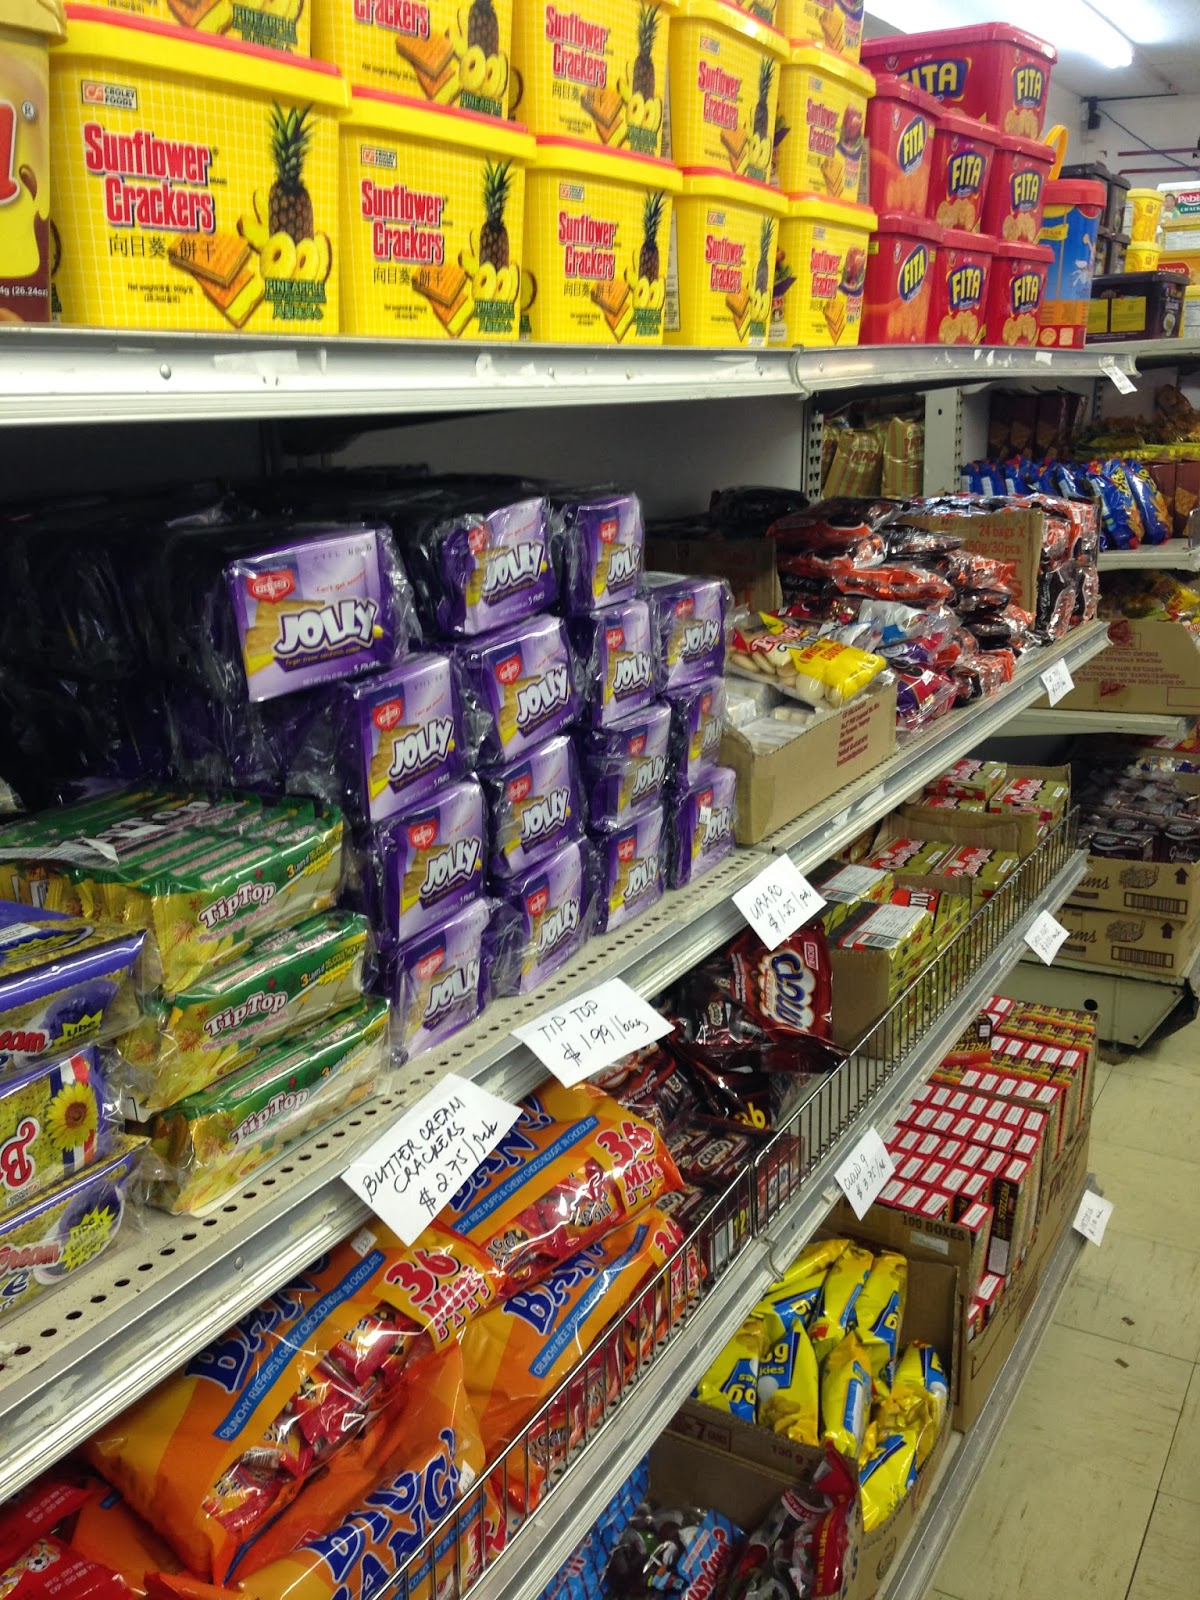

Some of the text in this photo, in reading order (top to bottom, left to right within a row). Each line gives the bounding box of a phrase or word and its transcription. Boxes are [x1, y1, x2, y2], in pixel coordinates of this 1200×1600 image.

[353, 0, 431, 40] Crackers
[545, 4, 608, 55] Sunflower
[552, 41, 607, 88] Crackers
[698, 59, 742, 103] Sunflower
[1017, 68, 1043, 101] FITA
[703, 91, 739, 131] Crackers
[84, 122, 212, 186] Sunflower
[903, 121, 925, 165] FITA
[952, 154, 982, 195] FITA
[1014, 173, 1039, 206] FITA
[104, 174, 216, 235] Crackers
[361, 177, 444, 228] Sunflower
[372, 219, 445, 267] Crackers
[558, 211, 617, 251] Sunflower
[705, 234, 745, 269] Sunflower
[564, 244, 616, 281] Crackers
[710, 262, 742, 295] Crackers
[811, 246, 842, 277] Sunflower
[903, 248, 925, 294] FITA
[265, 278, 326, 298] PINEAPPLE
[811, 271, 840, 300] Crackers
[952, 268, 981, 304] FITA
[1014, 275, 1039, 308] FITA
[993, 527, 1015, 540] bags
[482, 540, 545, 598] JOLLY
[273, 598, 378, 657] JOLLY
[681, 618, 720, 657] JOLLY
[515, 662, 570, 729] JOLLY
[612, 651, 652, 695] JOLLY
[388, 714, 455, 782] JOLLY
[631, 755, 667, 796] JOLLY
[518, 785, 571, 844] JOLLY
[700, 806, 735, 846] JOLLY
[419, 835, 482, 898] JOLLY
[622, 857, 660, 902] JOLLY
[198, 881, 276, 929] TipTop
[538, 895, 582, 954] JOLLY
[203, 991, 288, 1038] TipTop
[537, 999, 599, 1044] TIP TOP
[562, 1042, 581, 1067] $
[226, 1086, 309, 1148] TipTop
[362, 1095, 466, 1203] BUTTER CREAM
[392, 1120, 466, 1194] CRACKERS
[595, 1119, 656, 1170] 36
[468, 1207, 486, 1223] RICE
[482, 1194, 502, 1212] PUFFS
[567, 1116, 598, 1141] CHOCOLATE
[843, 1153, 867, 1191] CLOUD 9
[418, 1187, 437, 1217] $
[902, 1214, 966, 1242] 100 BOXES
[383, 1248, 461, 1306] 36
[433, 1283, 491, 1343] BARS
[219, 1397, 253, 1439] CRUNCHY
[299, 1304, 328, 1335] CHOCO
[349, 1252, 384, 1288] CHOCOLATE
[533, 1346, 556, 1376] CRUNCHY
[554, 1329, 570, 1350] RICE
